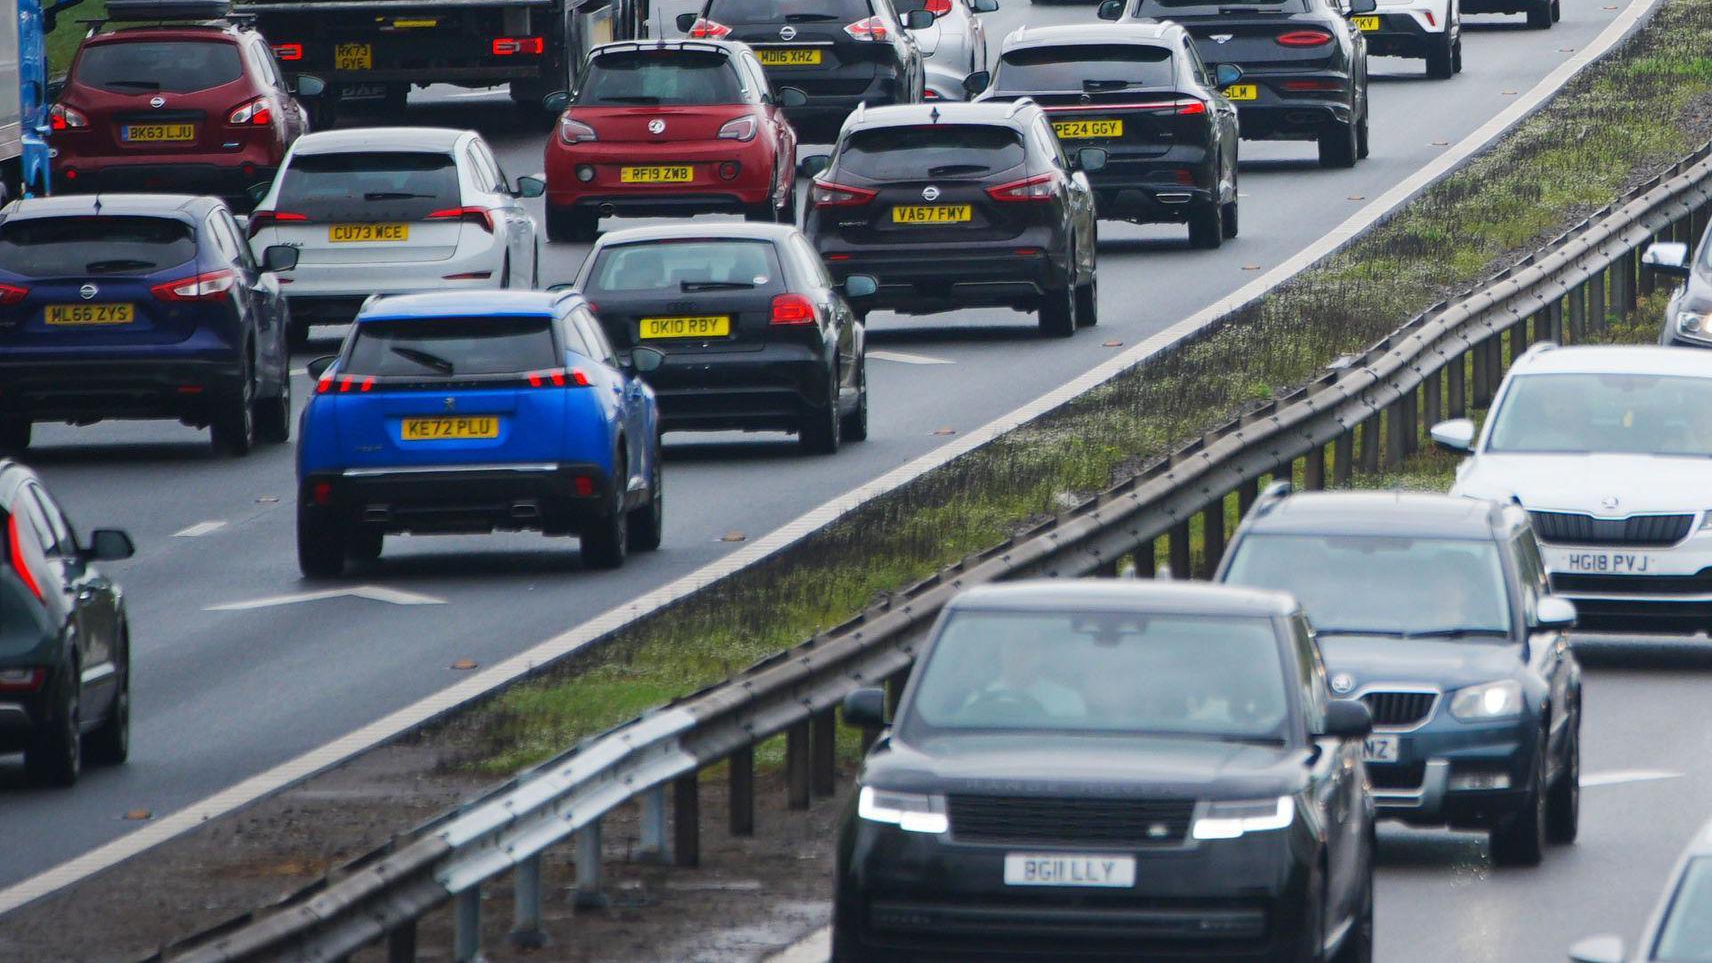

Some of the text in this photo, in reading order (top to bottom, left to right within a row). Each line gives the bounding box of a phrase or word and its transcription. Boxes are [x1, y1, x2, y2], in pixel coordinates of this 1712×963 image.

[337, 45, 368, 57] RK73
[790, 51, 813, 62] XHZ
[130, 125, 192, 139] BK63 LJU
[1056, 123, 1116, 136] PE24 GGY
[632, 167, 688, 180] RF19 ZWB
[898, 206, 965, 221] VA67 FMY
[334, 225, 403, 240] CU73 WCE
[52, 306, 128, 322] ML66 ZYS
[651, 318, 719, 335] OK10 RBY
[408, 418, 490, 436] KE72 PLU
[1569, 554, 1648, 572] HG18 PVJ
[1362, 740, 1388, 759] NZ
[1024, 860, 1115, 882] BG11 LLY
